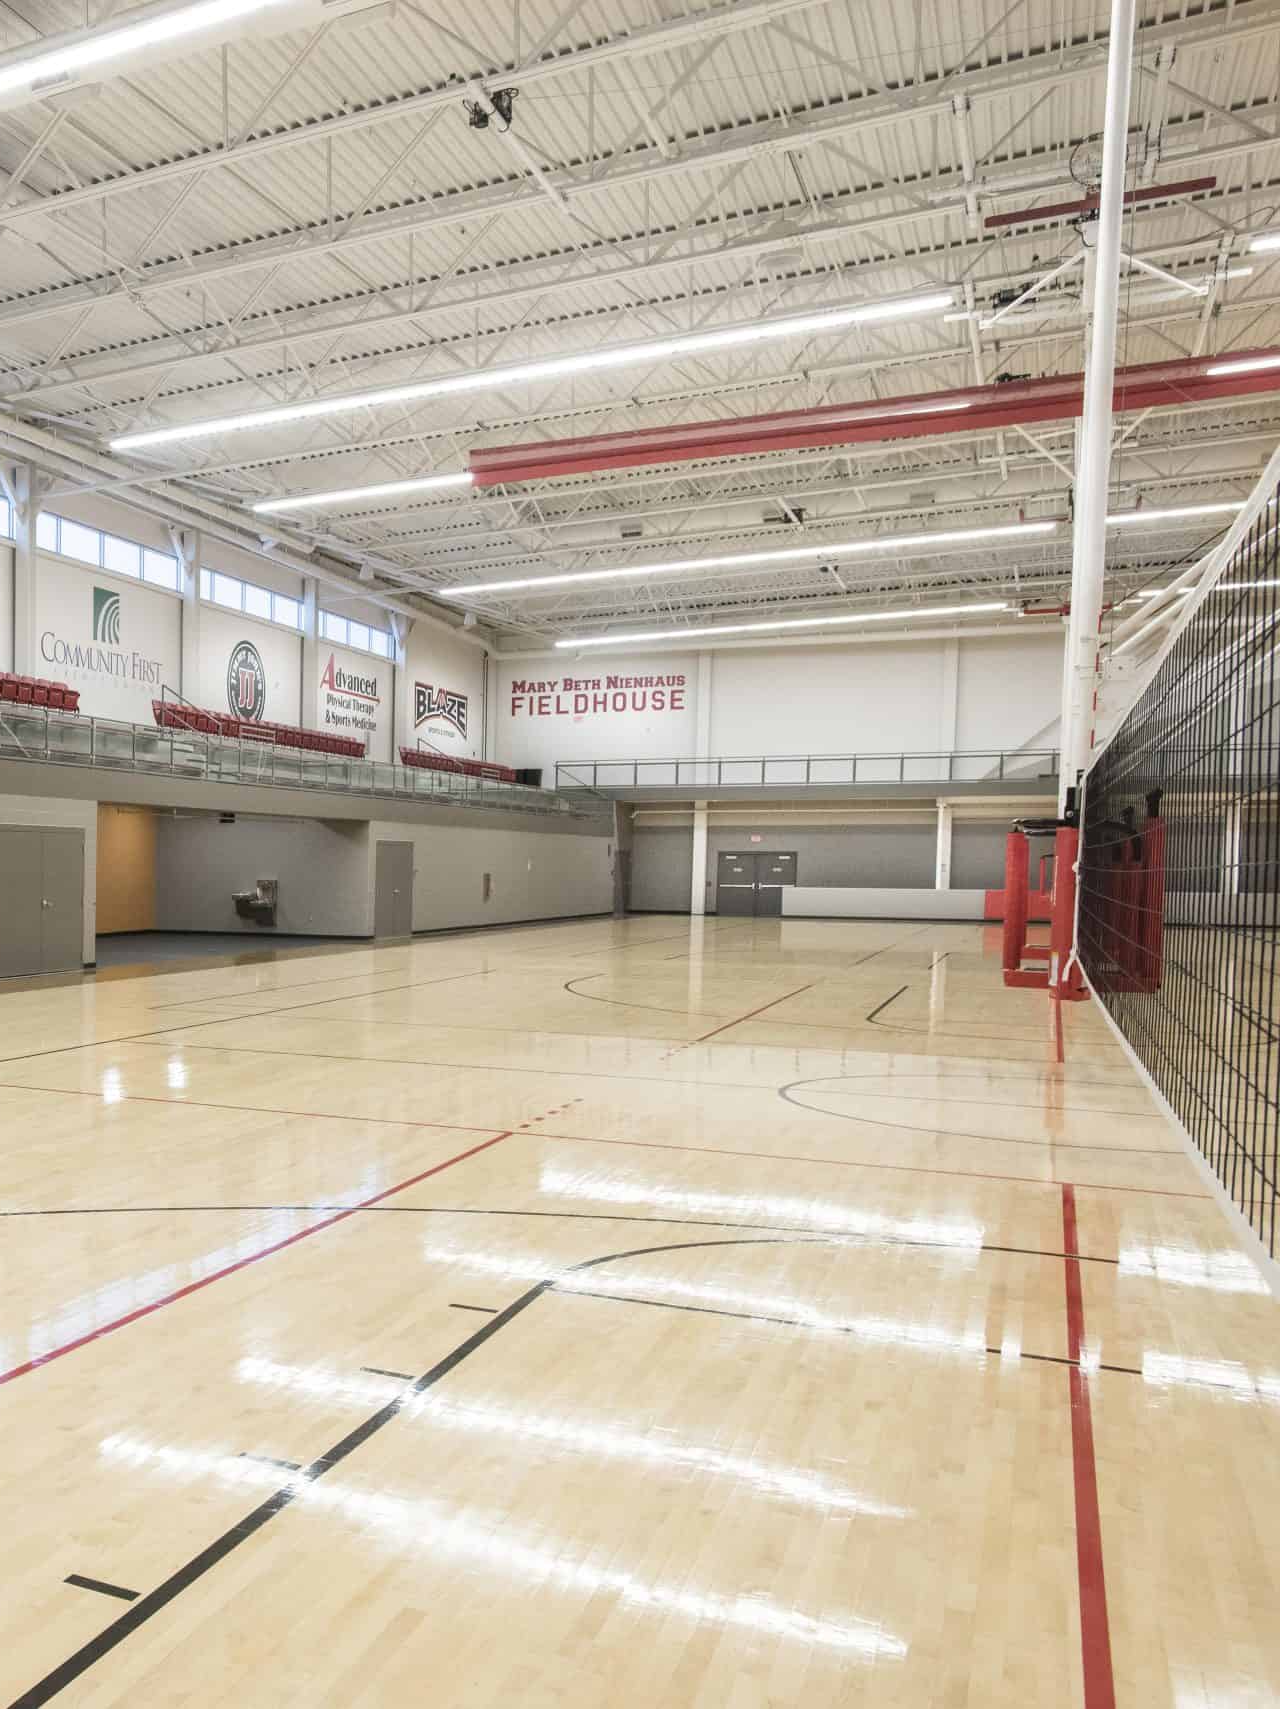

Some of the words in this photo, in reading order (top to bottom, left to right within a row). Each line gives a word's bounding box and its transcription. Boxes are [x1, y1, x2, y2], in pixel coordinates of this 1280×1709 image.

[40, 631, 129, 678] COMMUNITY
[131, 652, 163, 685] FIRST
[320, 653, 377, 697] Advanced
[511, 680, 559, 694] MARY
[563, 677, 601, 692] BETH
[606, 675, 686, 690] NIENHAUS
[326, 693, 352, 709] Physical
[352, 699, 375, 716] Therapy
[416, 687, 467, 735] BLAZE
[511, 689, 686, 717] FIELDHOUSE
[325, 709, 331, 724] &
[331, 711, 351, 727] Sports
[351, 716, 377, 731] Medicine
